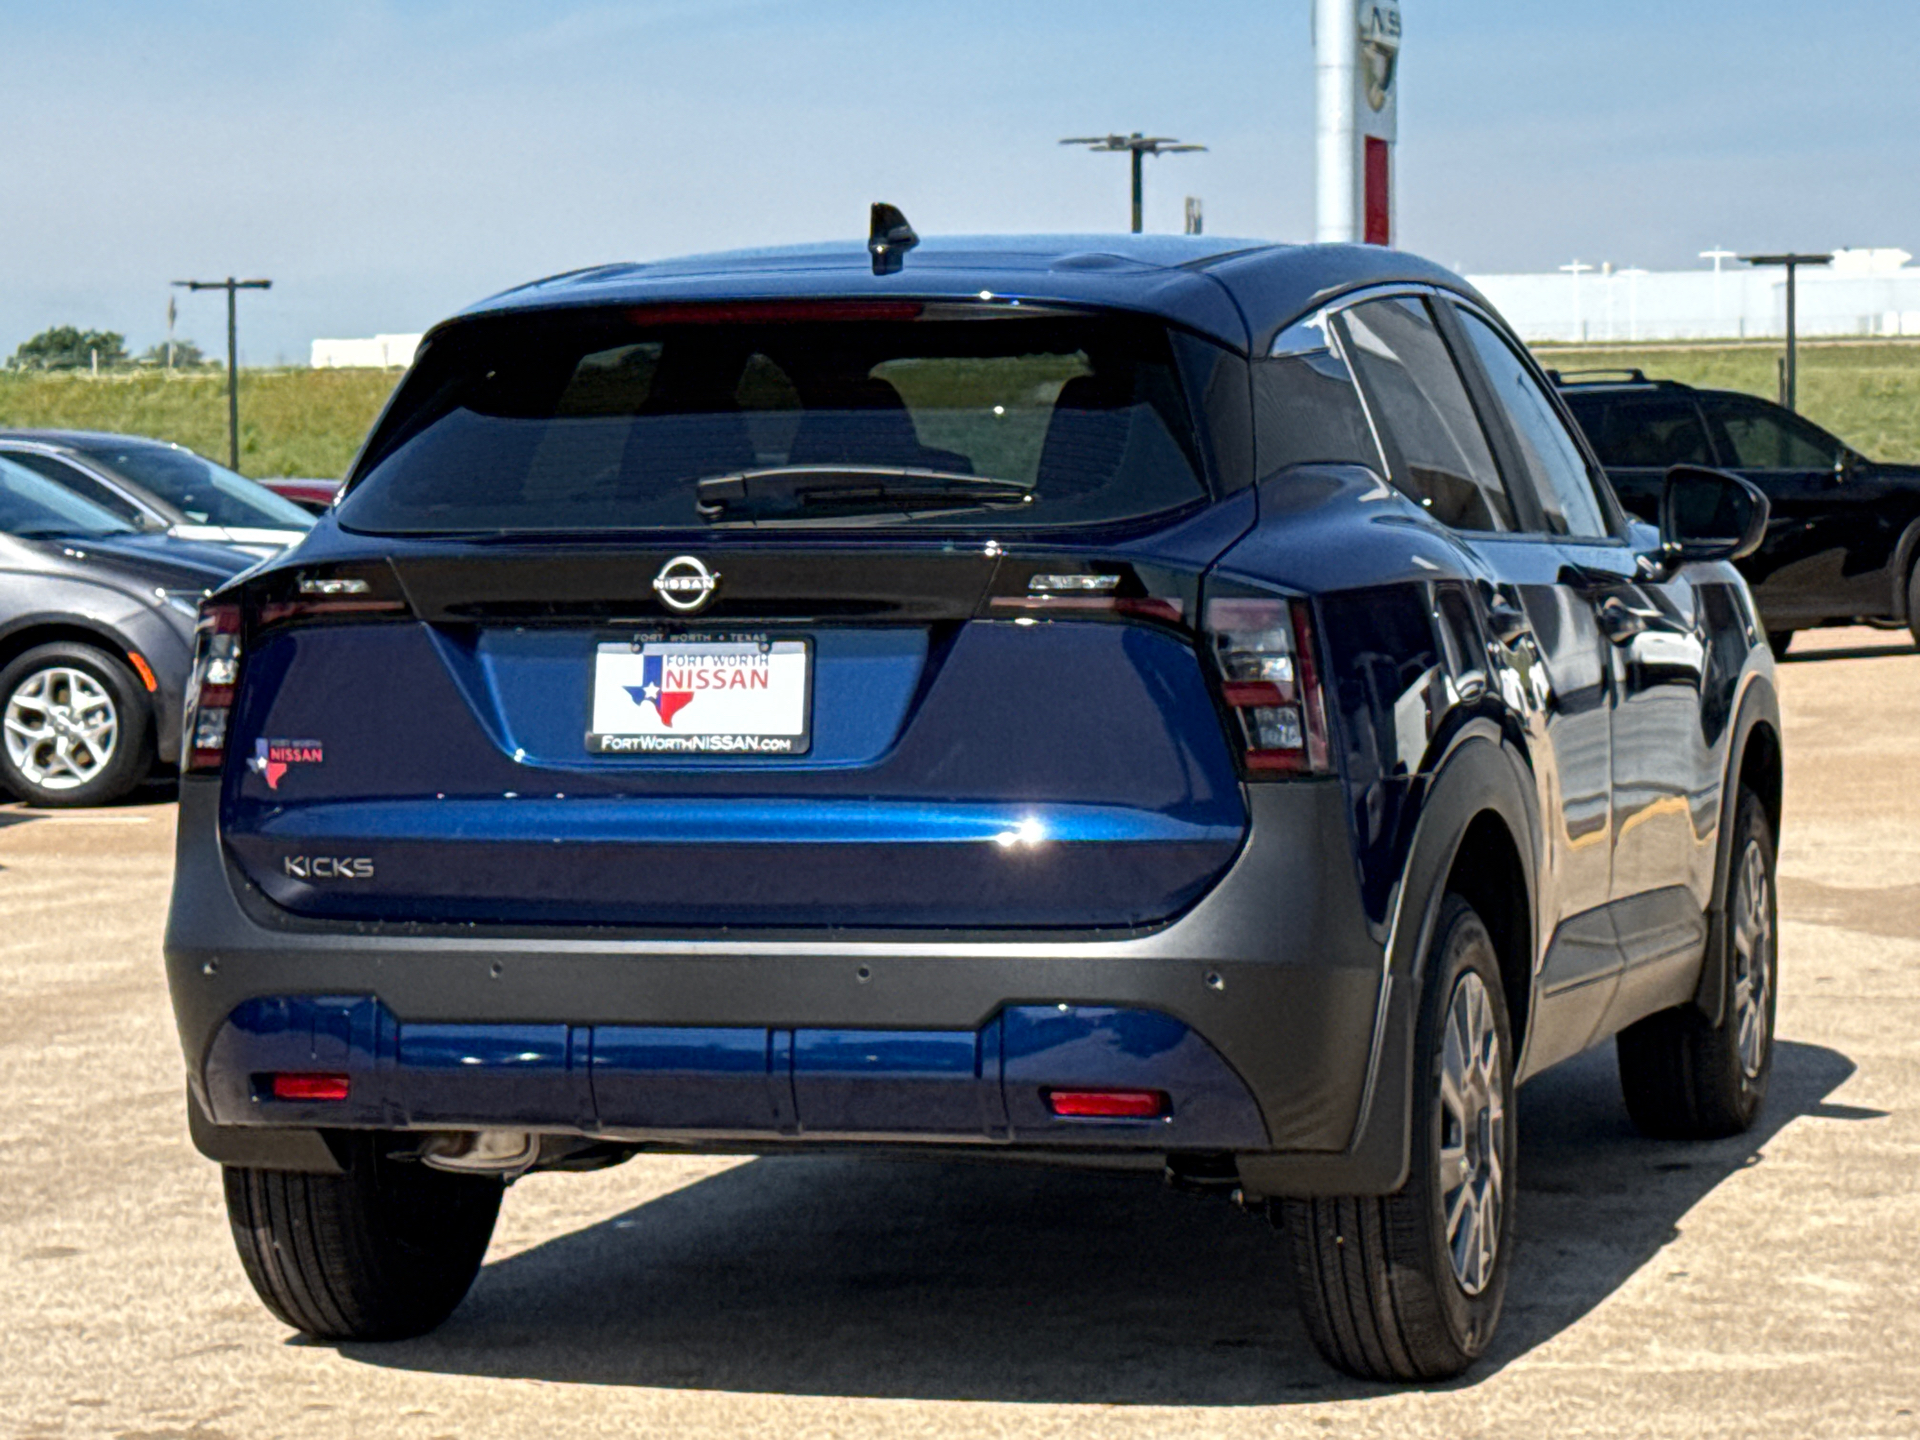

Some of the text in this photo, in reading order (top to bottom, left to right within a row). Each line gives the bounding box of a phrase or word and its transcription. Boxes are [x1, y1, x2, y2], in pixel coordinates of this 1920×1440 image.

[653, 578, 715, 590] NISSAN
[634, 633, 768, 643] FORT WORTH TEXAS
[666, 655, 769, 667] FORT WORTH
[667, 669, 768, 690] NISSAN
[270, 748, 323, 763] NISSAN
[284, 856, 375, 878] KICKS
